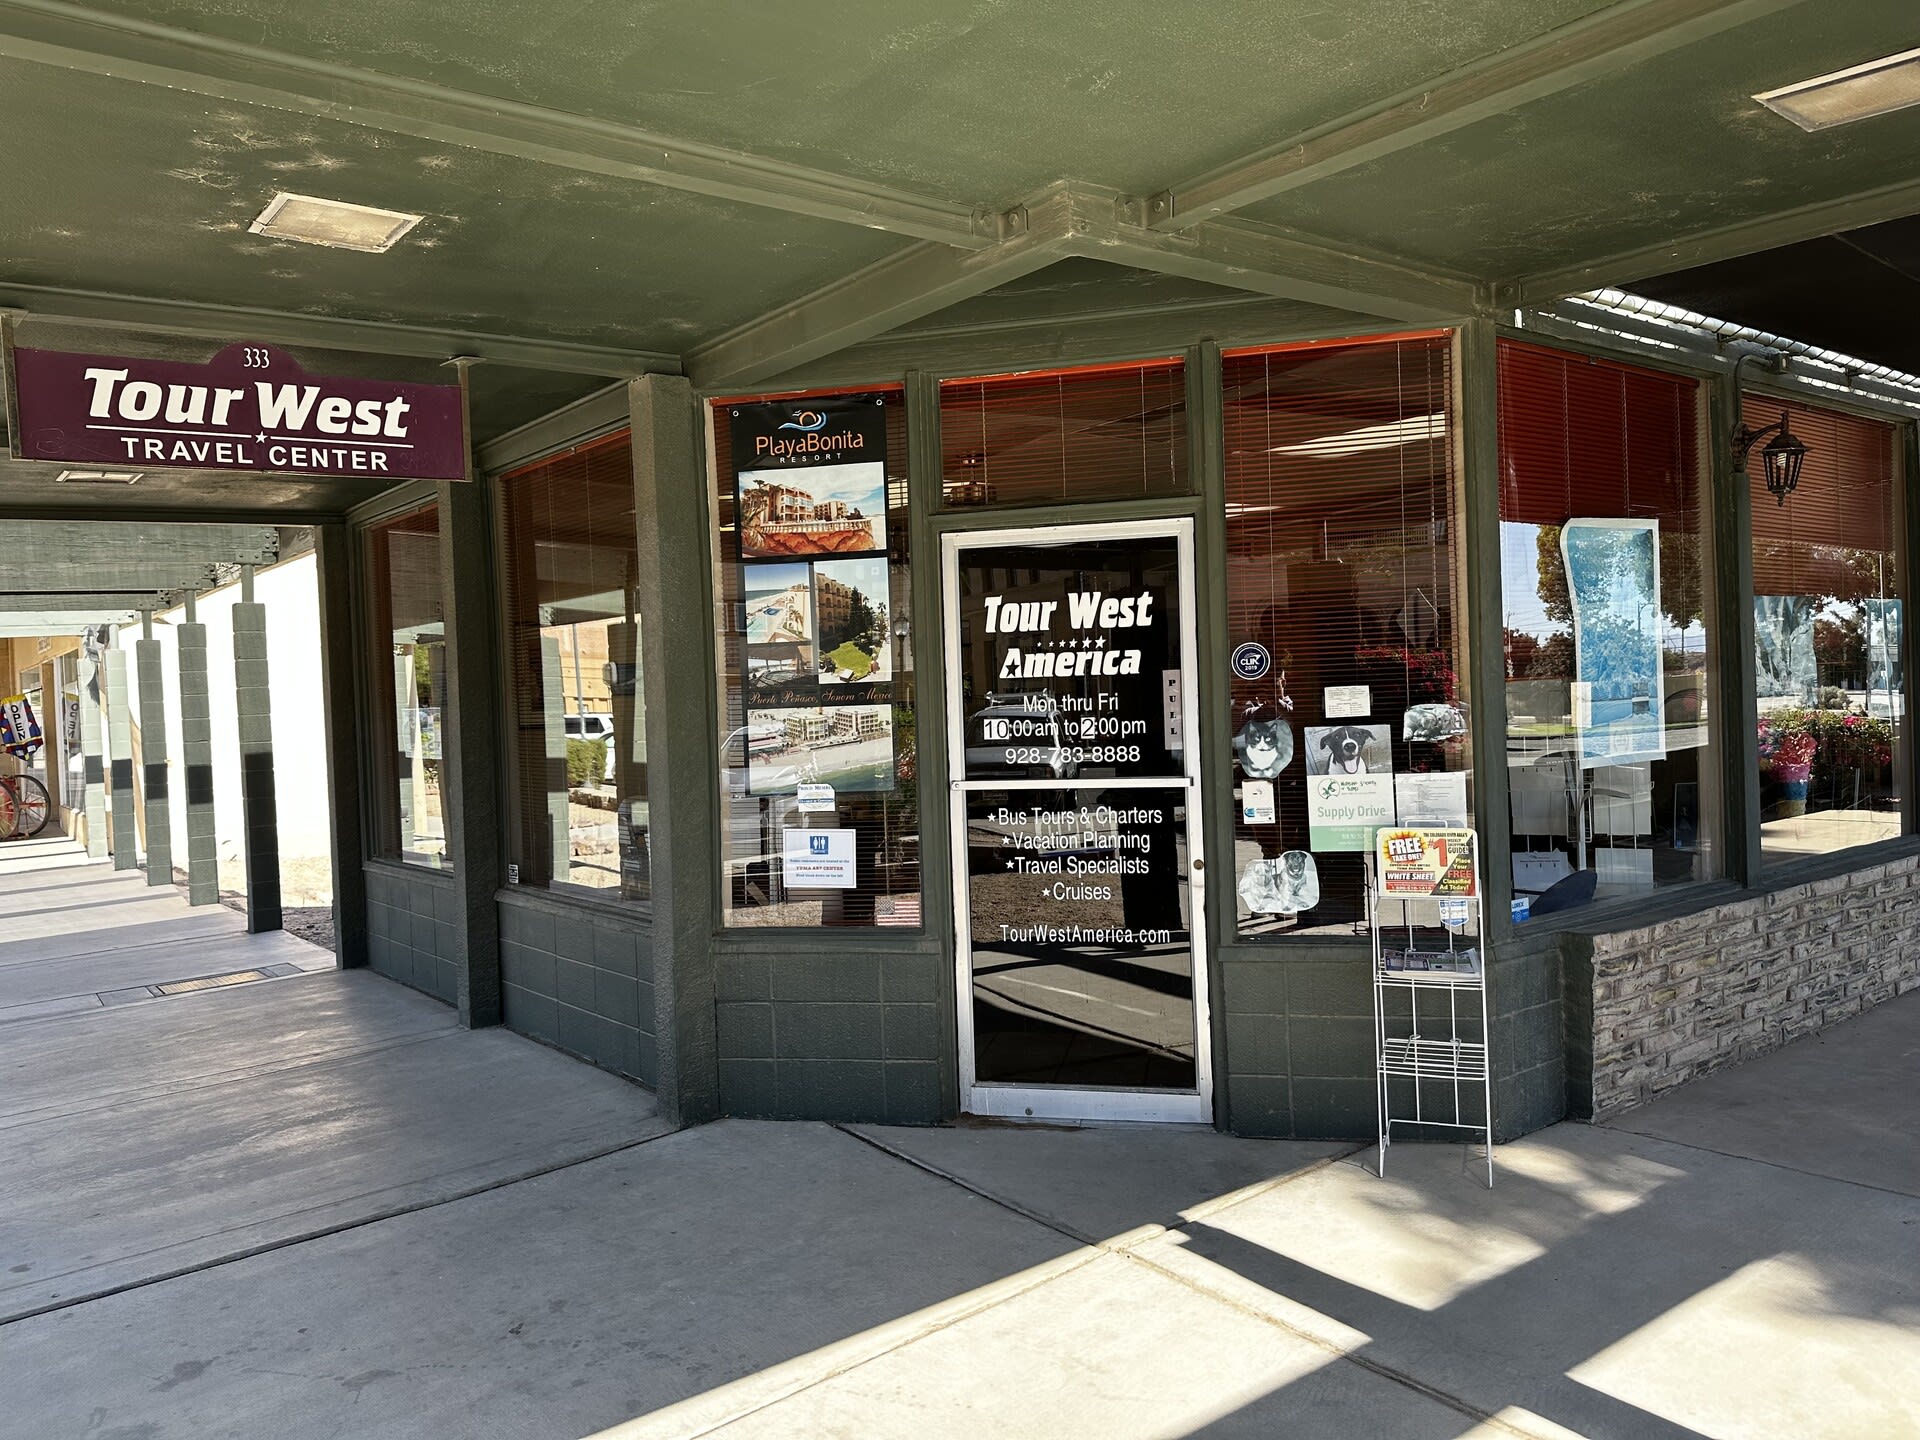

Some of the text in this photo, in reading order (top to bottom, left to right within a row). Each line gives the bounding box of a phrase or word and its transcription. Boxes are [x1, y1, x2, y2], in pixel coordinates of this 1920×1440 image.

[243, 347, 270, 369] 333
[84, 367, 411, 438] Tour West
[120, 436, 389, 472] TRAVEL CENTER
[755, 430, 864, 458] PlayaBonita
[779, 452, 843, 463] RESORT
[984, 591, 1153, 633] Tour West
[999, 648, 1141, 679] America
[748, 691, 778, 705] Puerto
[821, 690, 855, 702] Sonora
[856, 687, 893, 701] Mexico
[1023, 692, 1119, 713] Mon thru Fri
[1168, 679, 1178, 735] PULL
[10, 705, 26, 741] OPEN
[1064, 721, 1079, 736] to
[1005, 746, 1141, 764] 928-783-8888
[998, 806, 1163, 826] Bus Tours & Charters
[1317, 804, 1387, 820] Supply Drive
[1012, 831, 1151, 852] Vacation Planning
[1388, 837, 1423, 855] FREE
[1015, 856, 1150, 878] Travel Specialists
[1391, 853, 1423, 862] TAKE ONE!
[1412, 872, 1434, 880] SHEET
[1447, 870, 1472, 878] FREE
[1053, 882, 1111, 900] Cruises
[1000, 925, 1171, 943] TourWestAmerica.com
